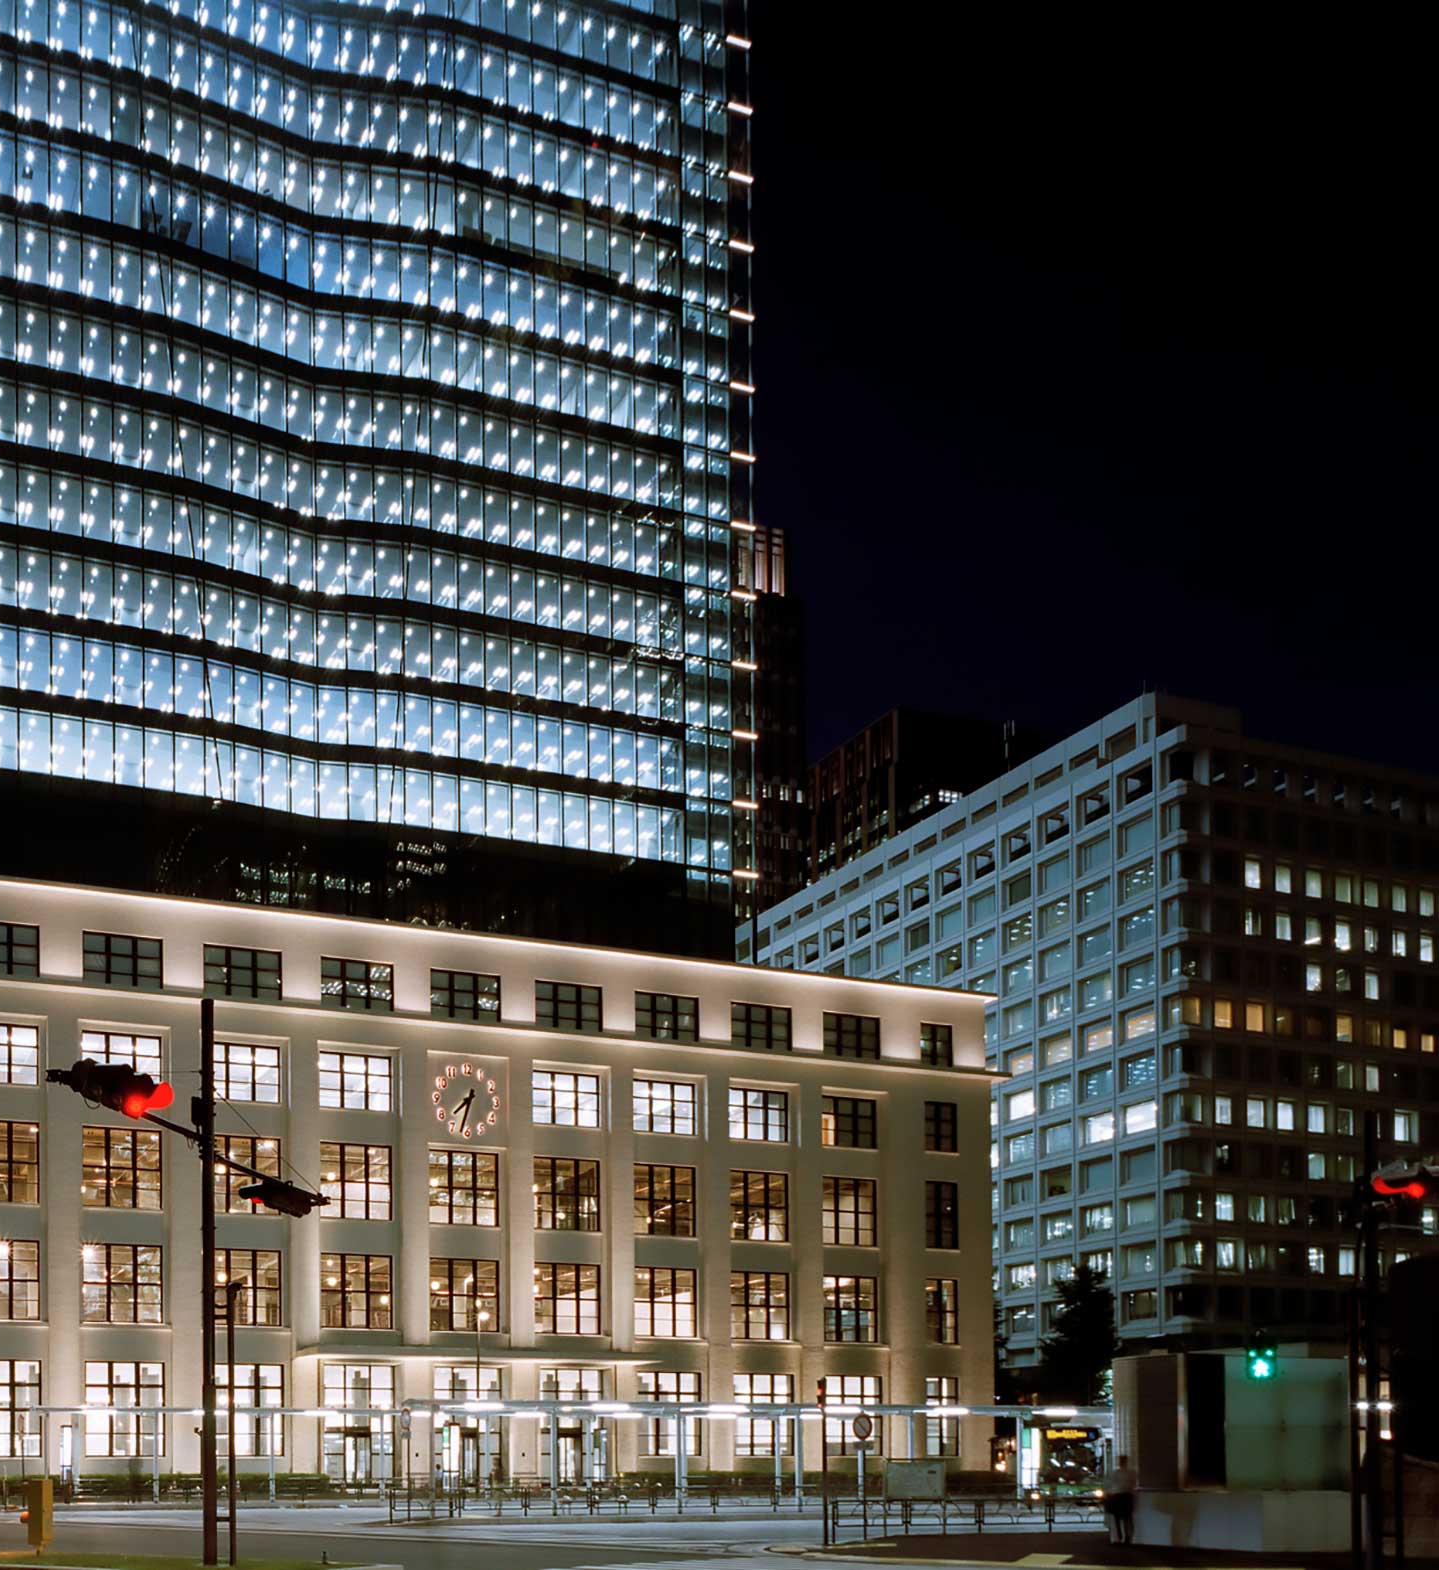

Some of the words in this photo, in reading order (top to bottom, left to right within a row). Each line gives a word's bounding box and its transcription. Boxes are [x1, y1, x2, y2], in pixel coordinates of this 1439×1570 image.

[446, 1066, 456, 1078] 11
[462, 1064, 472, 1076] 12
[478, 1069, 484, 1080] 1
[436, 1077, 447, 1089] 10
[488, 1080, 495, 1094] 2
[432, 1092, 440, 1104] 9
[492, 1096, 500, 1110] 3
[437, 1108, 445, 1120] 8
[487, 1112, 496, 1124] 4
[448, 1120, 455, 1133] 7
[463, 1126, 471, 1138] 6
[477, 1122, 484, 1136] 5
